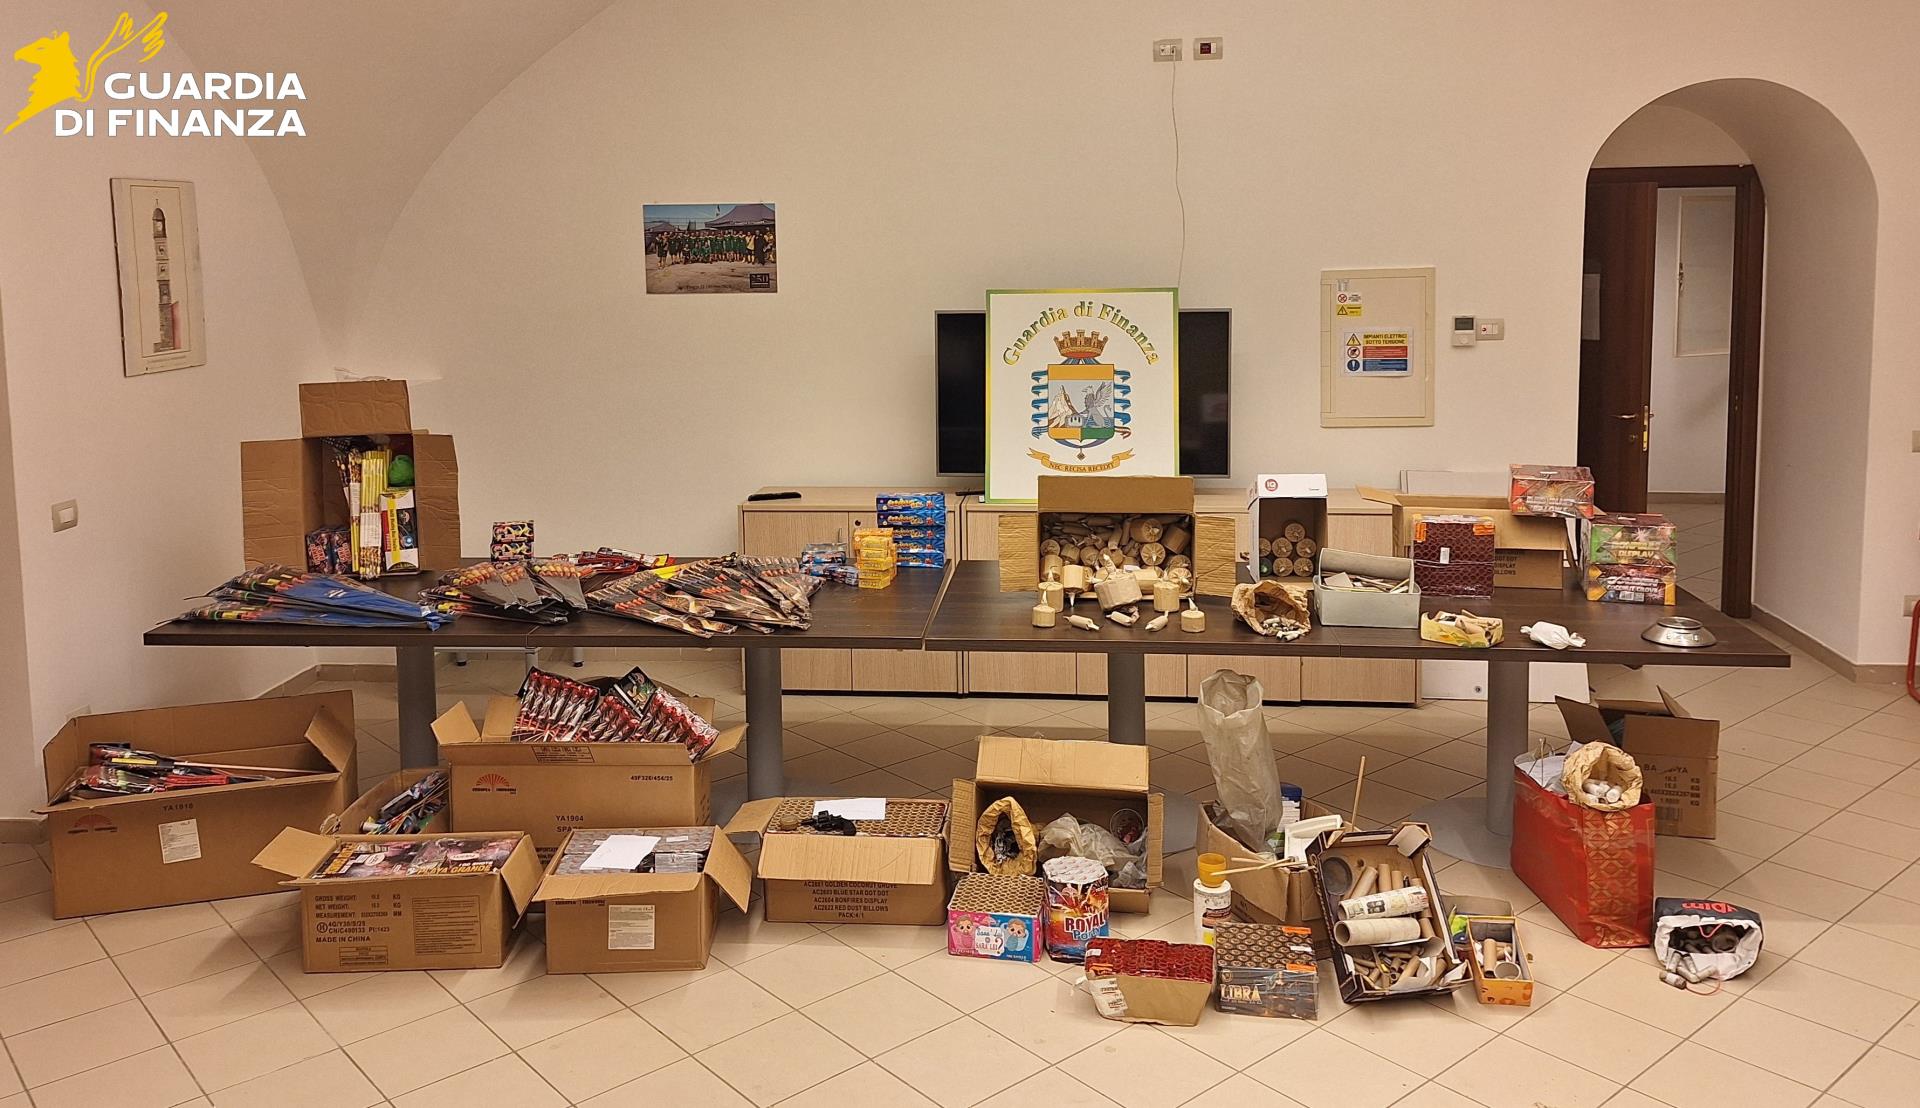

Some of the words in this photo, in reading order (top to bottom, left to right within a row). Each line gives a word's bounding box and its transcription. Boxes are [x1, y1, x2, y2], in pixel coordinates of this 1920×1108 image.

[1003, 307, 1068, 366] Guardia
[1073, 301, 1093, 318] di
[1097, 303, 1160, 365] Finanza
[1050, 463, 1062, 471] NEC
[416, 866, 449, 875] PLAYA
[450, 864, 492, 874] GRANDE
[1064, 911, 1105, 934] ROYAL
[1220, 983, 1263, 1004] LIBRA
